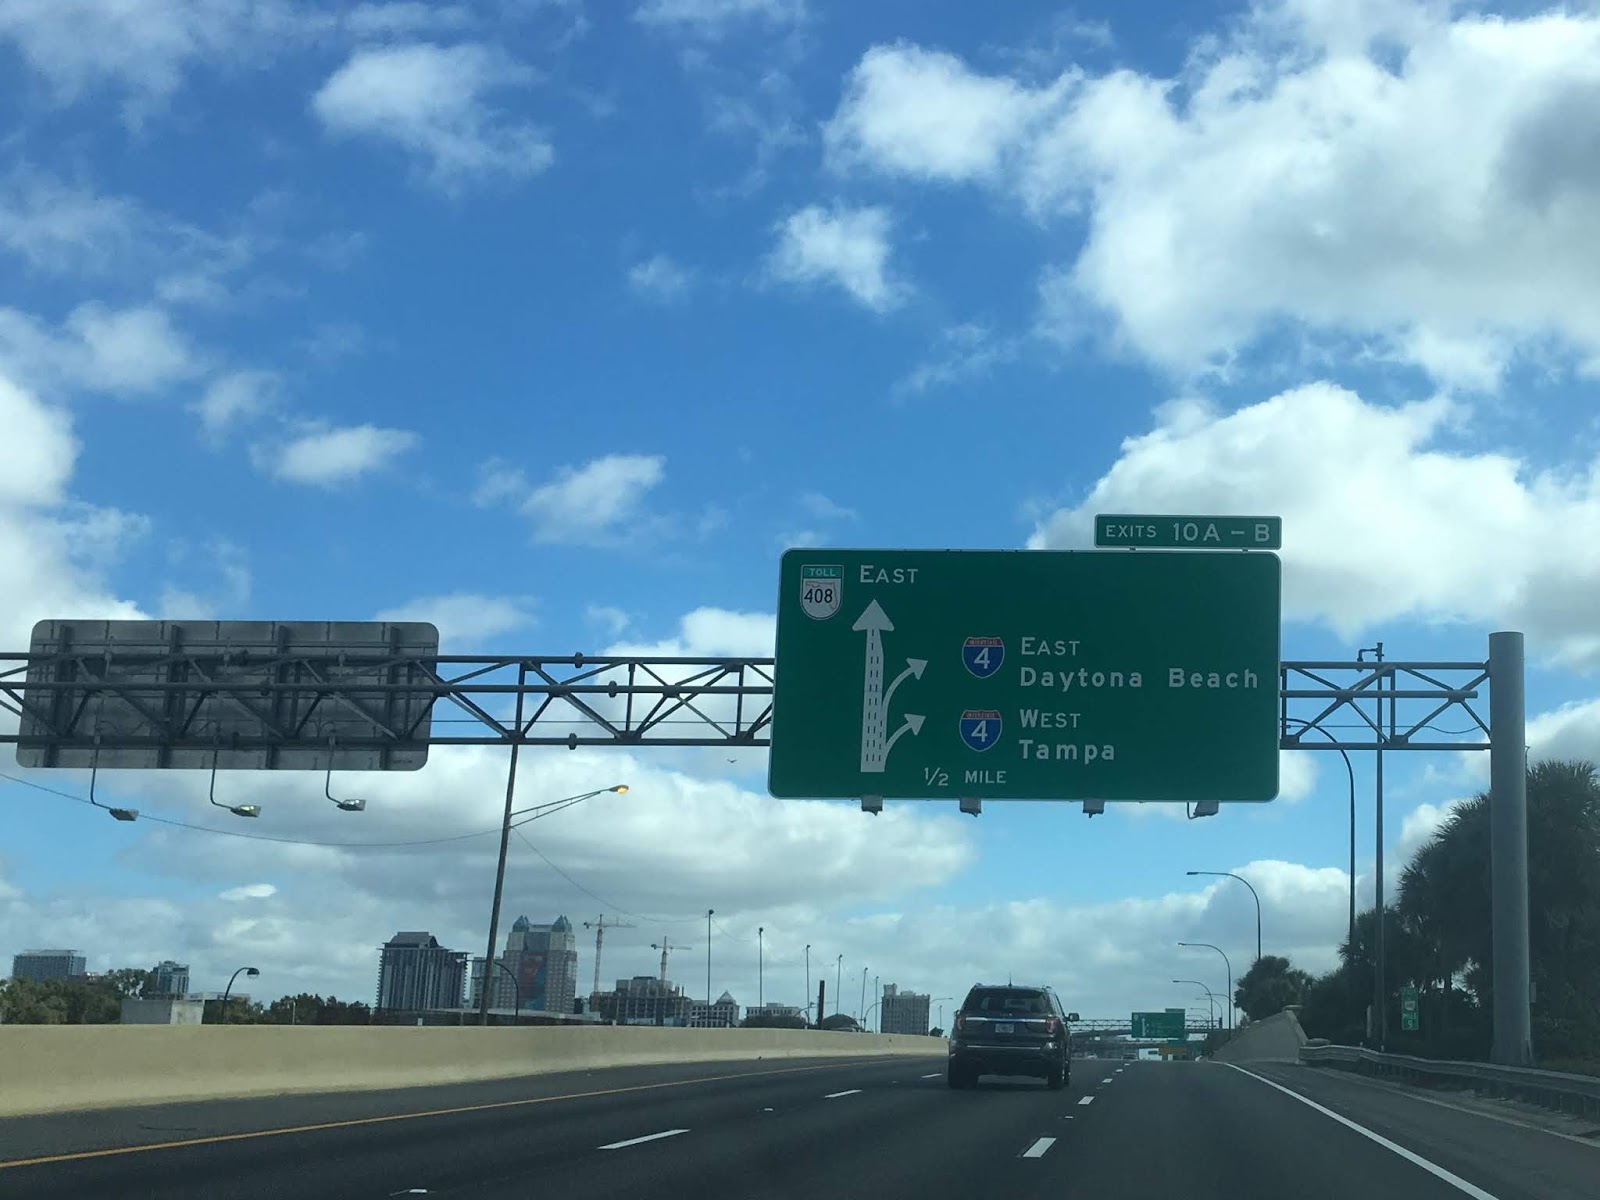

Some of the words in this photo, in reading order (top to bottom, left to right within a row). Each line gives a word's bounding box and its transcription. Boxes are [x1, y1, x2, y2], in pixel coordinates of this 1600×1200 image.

[1105, 524, 1158, 538] EXITS
[1173, 522, 1221, 542] 10A
[1254, 523, 1270, 542] B
[809, 567, 837, 577] TOLL
[860, 564, 919, 584] EAST
[803, 588, 833, 604] 408
[1020, 636, 1081, 656] EAST
[973, 647, 991, 669] 4
[1019, 666, 1143, 692] Daytona
[1168, 667, 1259, 688] Beach
[1019, 708, 1082, 728] WEST
[971, 720, 989, 743] 4
[1018, 739, 1115, 765] Tampa
[964, 770, 1007, 784] MILE
